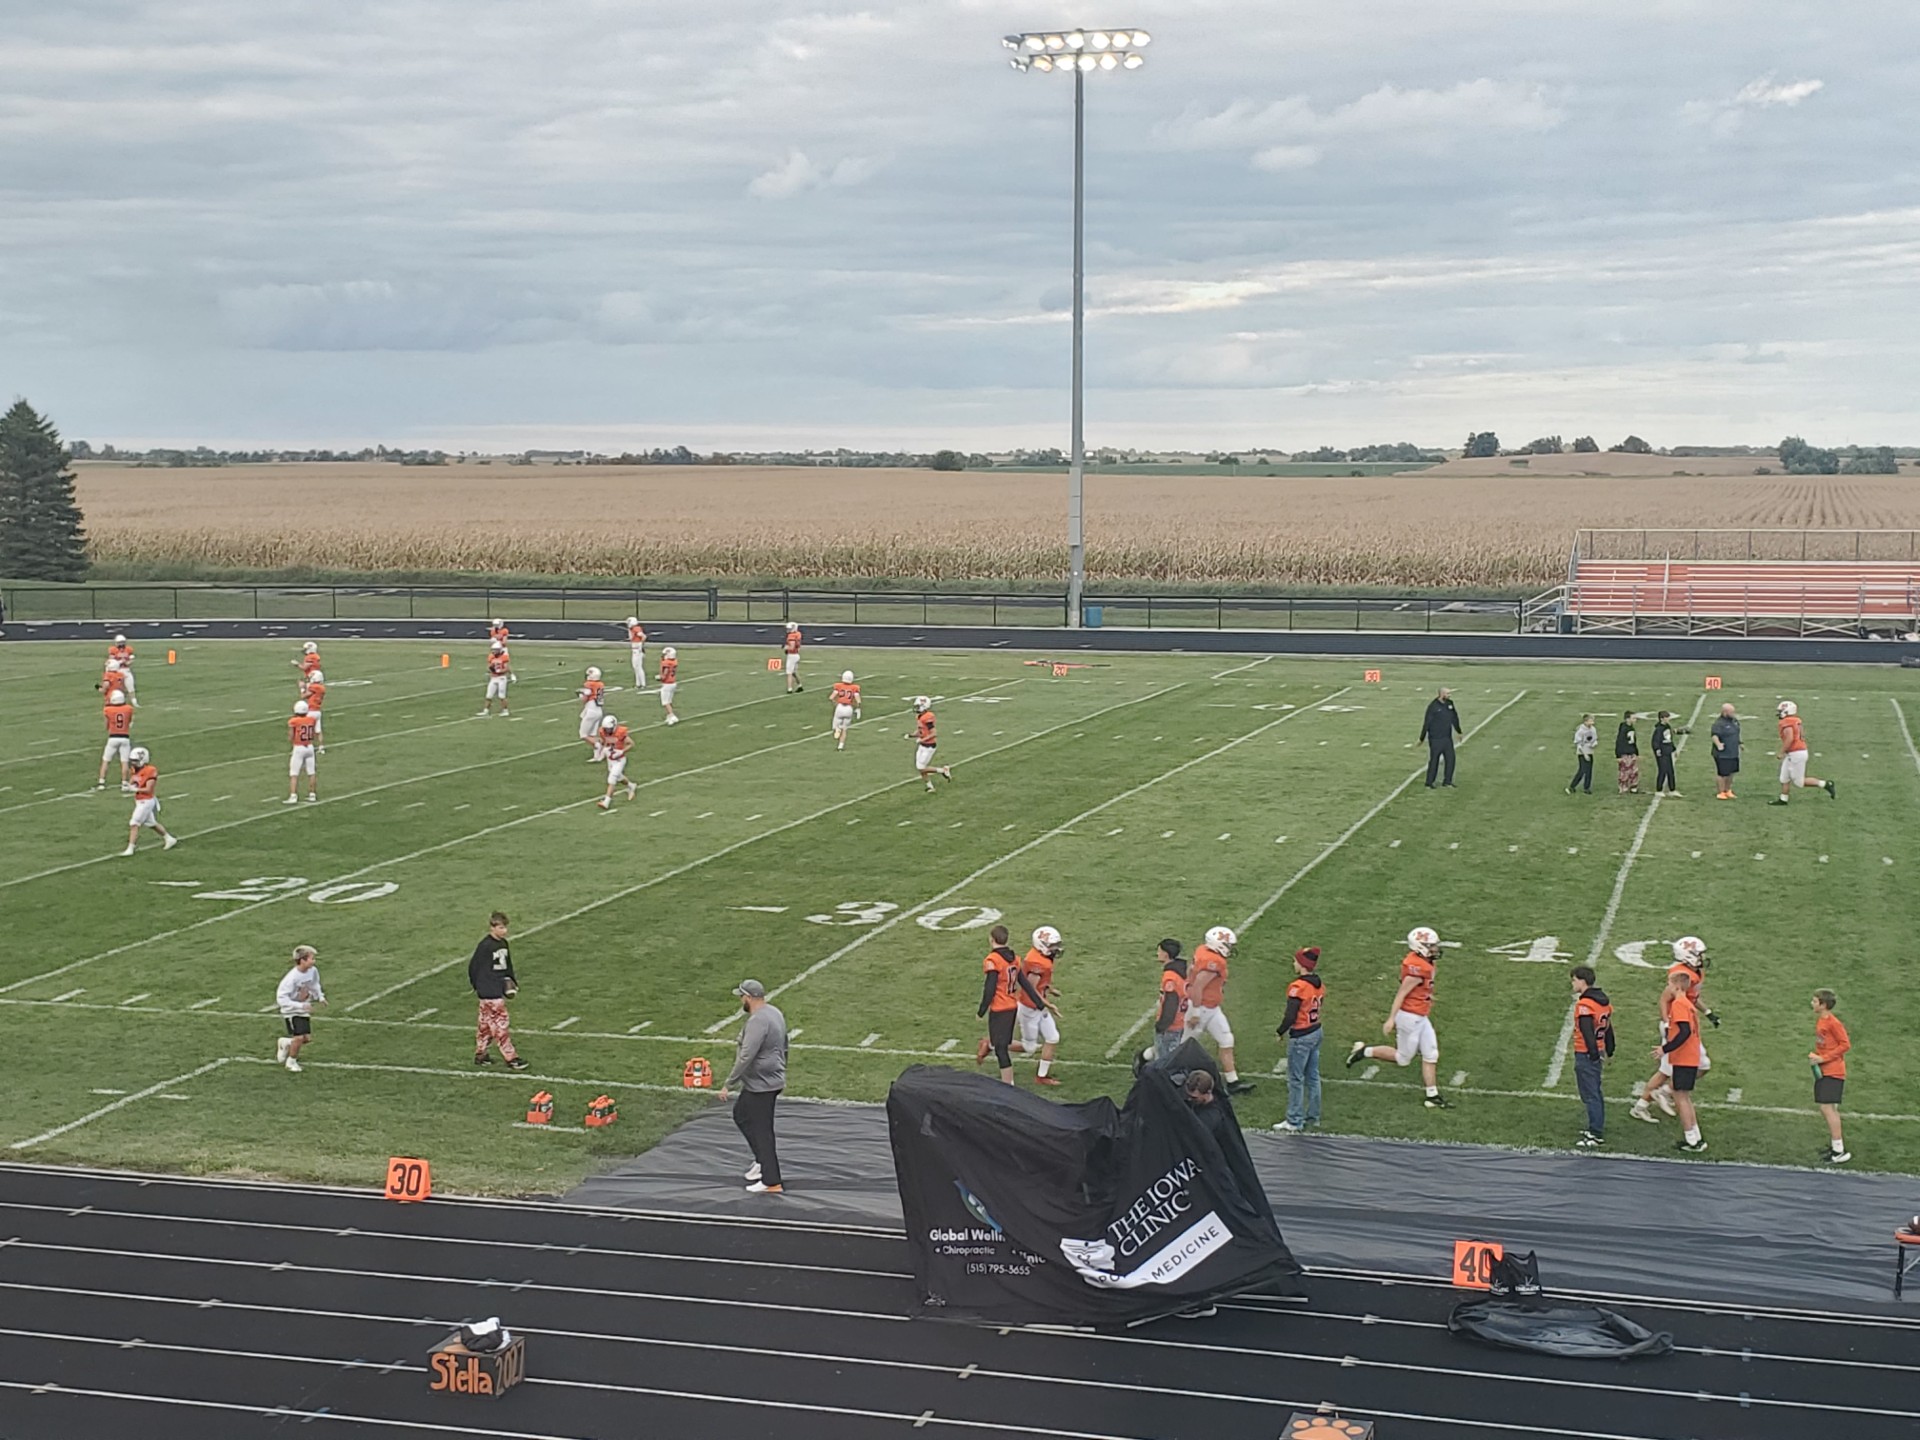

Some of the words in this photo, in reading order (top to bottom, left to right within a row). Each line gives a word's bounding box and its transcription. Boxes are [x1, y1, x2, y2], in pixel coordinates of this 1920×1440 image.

[1366, 671, 1378, 682] 30
[1707, 679, 1719, 689] 40
[116, 713, 124, 729] 9
[300, 725, 314, 741] 20
[803, 901, 1002, 931] 30
[390, 1163, 422, 1196] 30
[1107, 1197, 1151, 1243] THE
[1146, 1157, 1203, 1206] IOWA
[929, 1228, 969, 1241] Global
[1120, 1191, 1192, 1256] CLINIC
[942, 1245, 996, 1256] Chiropractic
[1151, 1226, 1219, 1280] MEDICINE
[1459, 1246, 1495, 1283] 40
[430, 1352, 493, 1395] Stella
